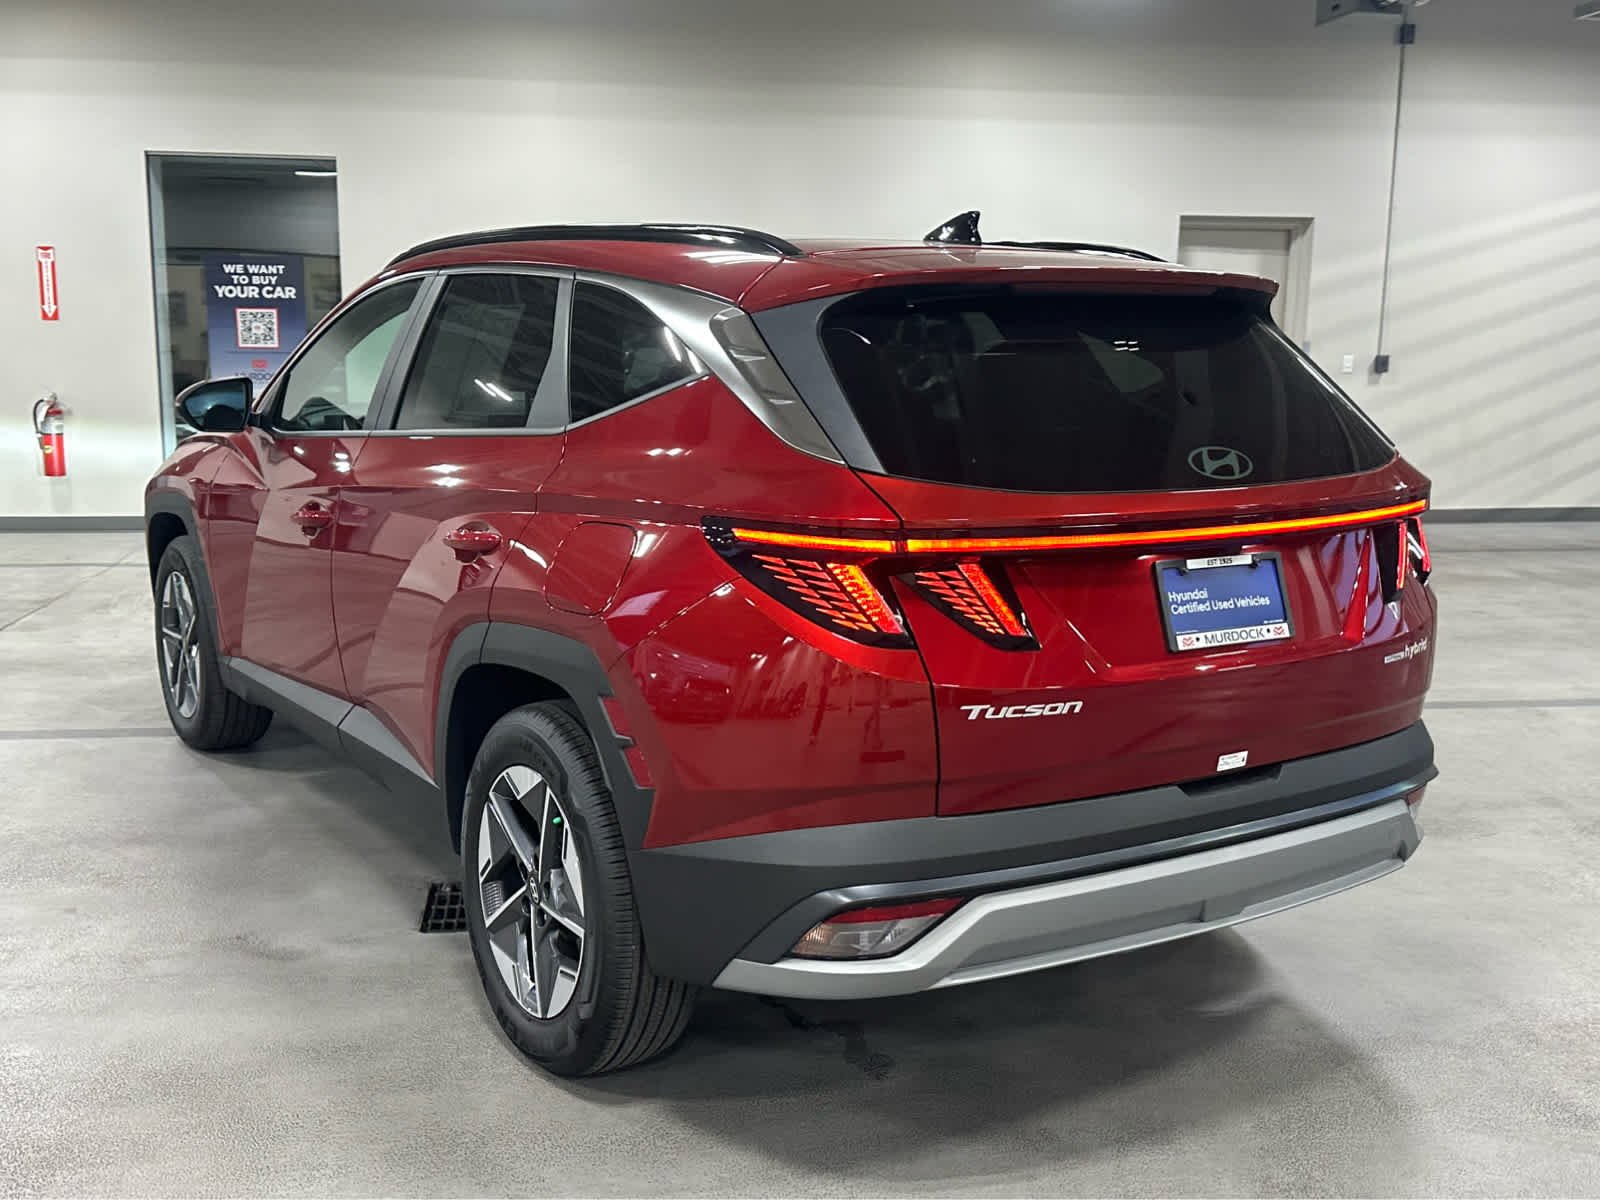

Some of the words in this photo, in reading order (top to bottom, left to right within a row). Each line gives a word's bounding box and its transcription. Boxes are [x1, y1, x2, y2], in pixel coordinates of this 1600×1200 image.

[223, 264, 244, 274] WE
[247, 264, 285, 275] WANT
[231, 275, 249, 285] TO
[252, 275, 278, 285] BUY
[214, 285, 259, 299] YOUR
[262, 286, 297, 299] CAR
[1168, 588, 1208, 603] Hyundai
[1171, 601, 1211, 614] Certified
[1211, 600, 1235, 611] Used
[1234, 595, 1271, 608] Vehicles
[1204, 627, 1265, 644] MURDOCK
